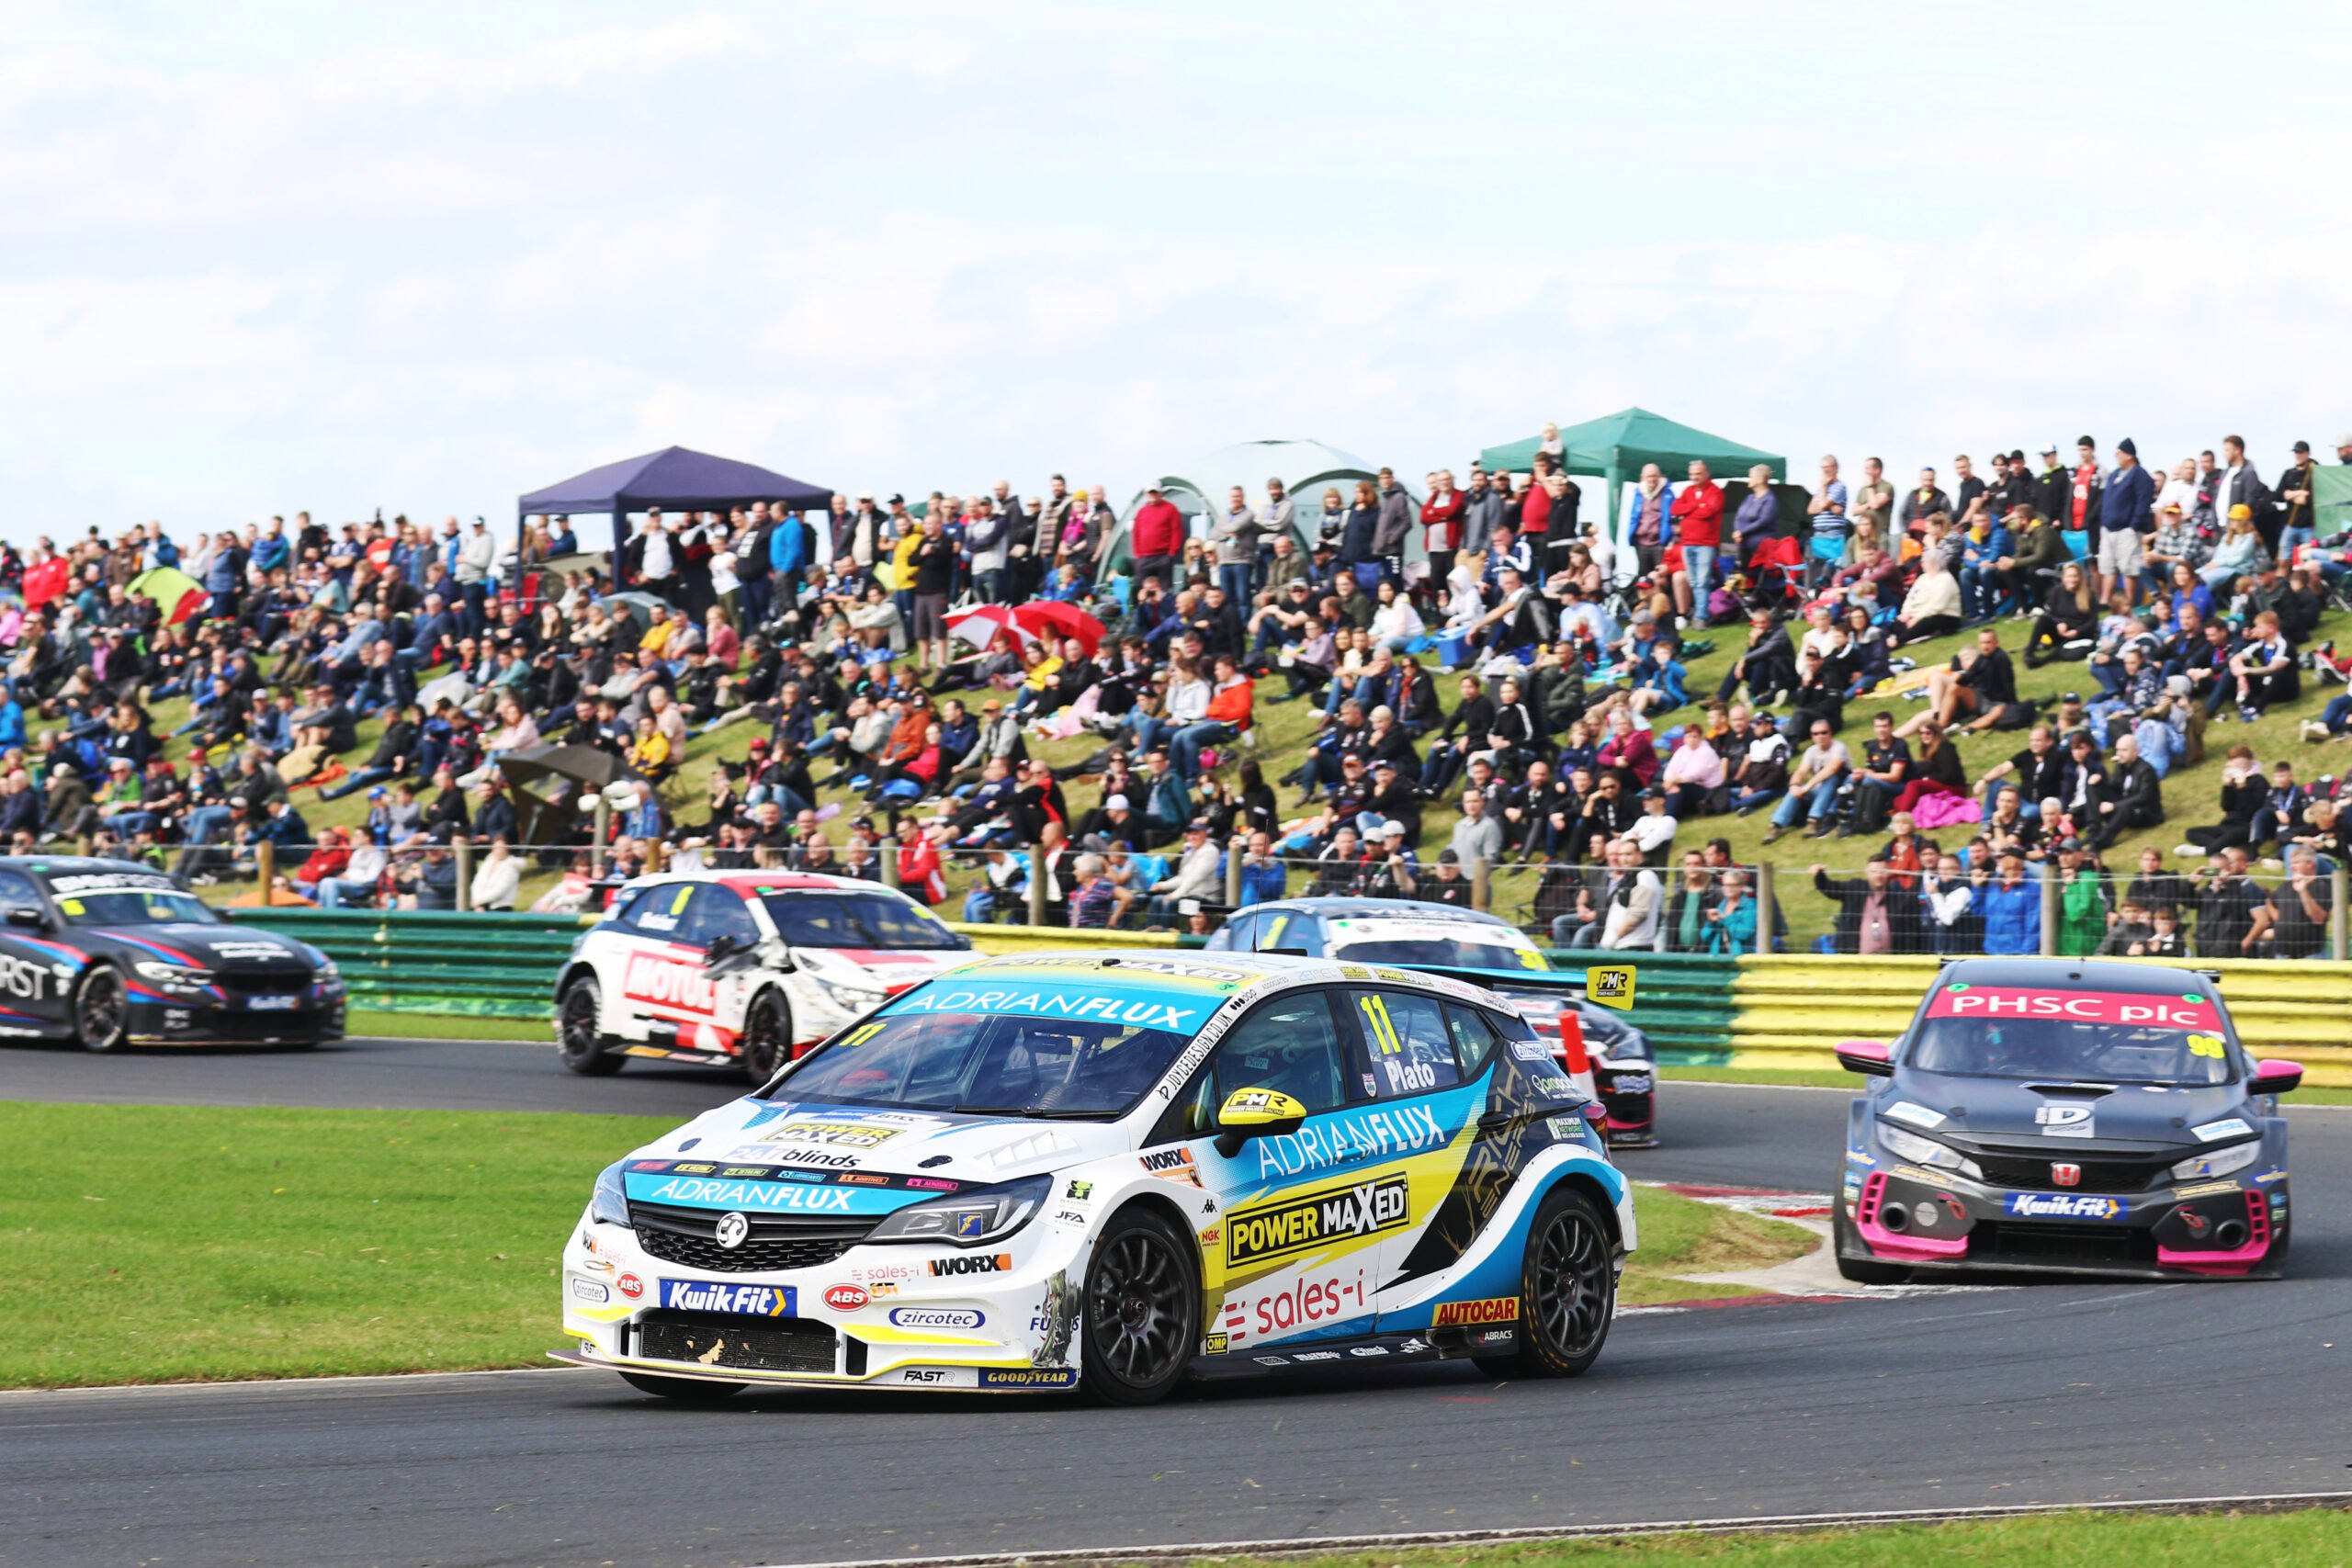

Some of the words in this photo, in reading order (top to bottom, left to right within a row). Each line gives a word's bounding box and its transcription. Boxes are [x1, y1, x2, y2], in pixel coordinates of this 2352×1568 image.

[1113, 961, 1245, 982] MAXED
[1599, 972, 1628, 988] PMR
[628, 955, 714, 1010] MOTUL
[899, 991, 1197, 1029] ADRIANFLUX
[1952, 996, 2103, 1017] PHSC
[2120, 1005, 2199, 1025] plc
[839, 1023, 888, 1046] 11
[1361, 995, 1402, 1055] 11
[1167, 1011, 1233, 1090] JOYCEDESIGN.CO.UK
[2187, 1034, 2225, 1059] 99
[1384, 1059, 1435, 1093] Plato
[1230, 1093, 1288, 1107] PMR
[771, 1131, 879, 1146] MAXED
[786, 1123, 893, 1139] POWER
[1258, 1105, 1446, 1180] ADRIANFLUX
[782, 1149, 862, 1168] blinds
[1140, 1149, 1187, 1171] WORX
[651, 1179, 856, 1210] ADRIANFLUX
[1055, 1211, 1085, 1224] JFA
[1232, 1206, 1319, 1257] POWER
[1323, 1182, 1406, 1235] MAXED
[1203, 1230, 1220, 1242] NGK
[867, 1266, 920, 1280] sales-i
[932, 1254, 1002, 1276] WORX
[620, 1279, 640, 1293] ABS
[829, 1291, 865, 1303] ABS
[1257, 1269, 1364, 1334] sales-i
[902, 1312, 974, 1325] zircotec
[1436, 1299, 1516, 1325] AUTOCAR
[1207, 1337, 1227, 1350] OMP
[1485, 1330, 1513, 1341] ABRACS
[988, 1372, 1069, 1383] GOODYEAR
